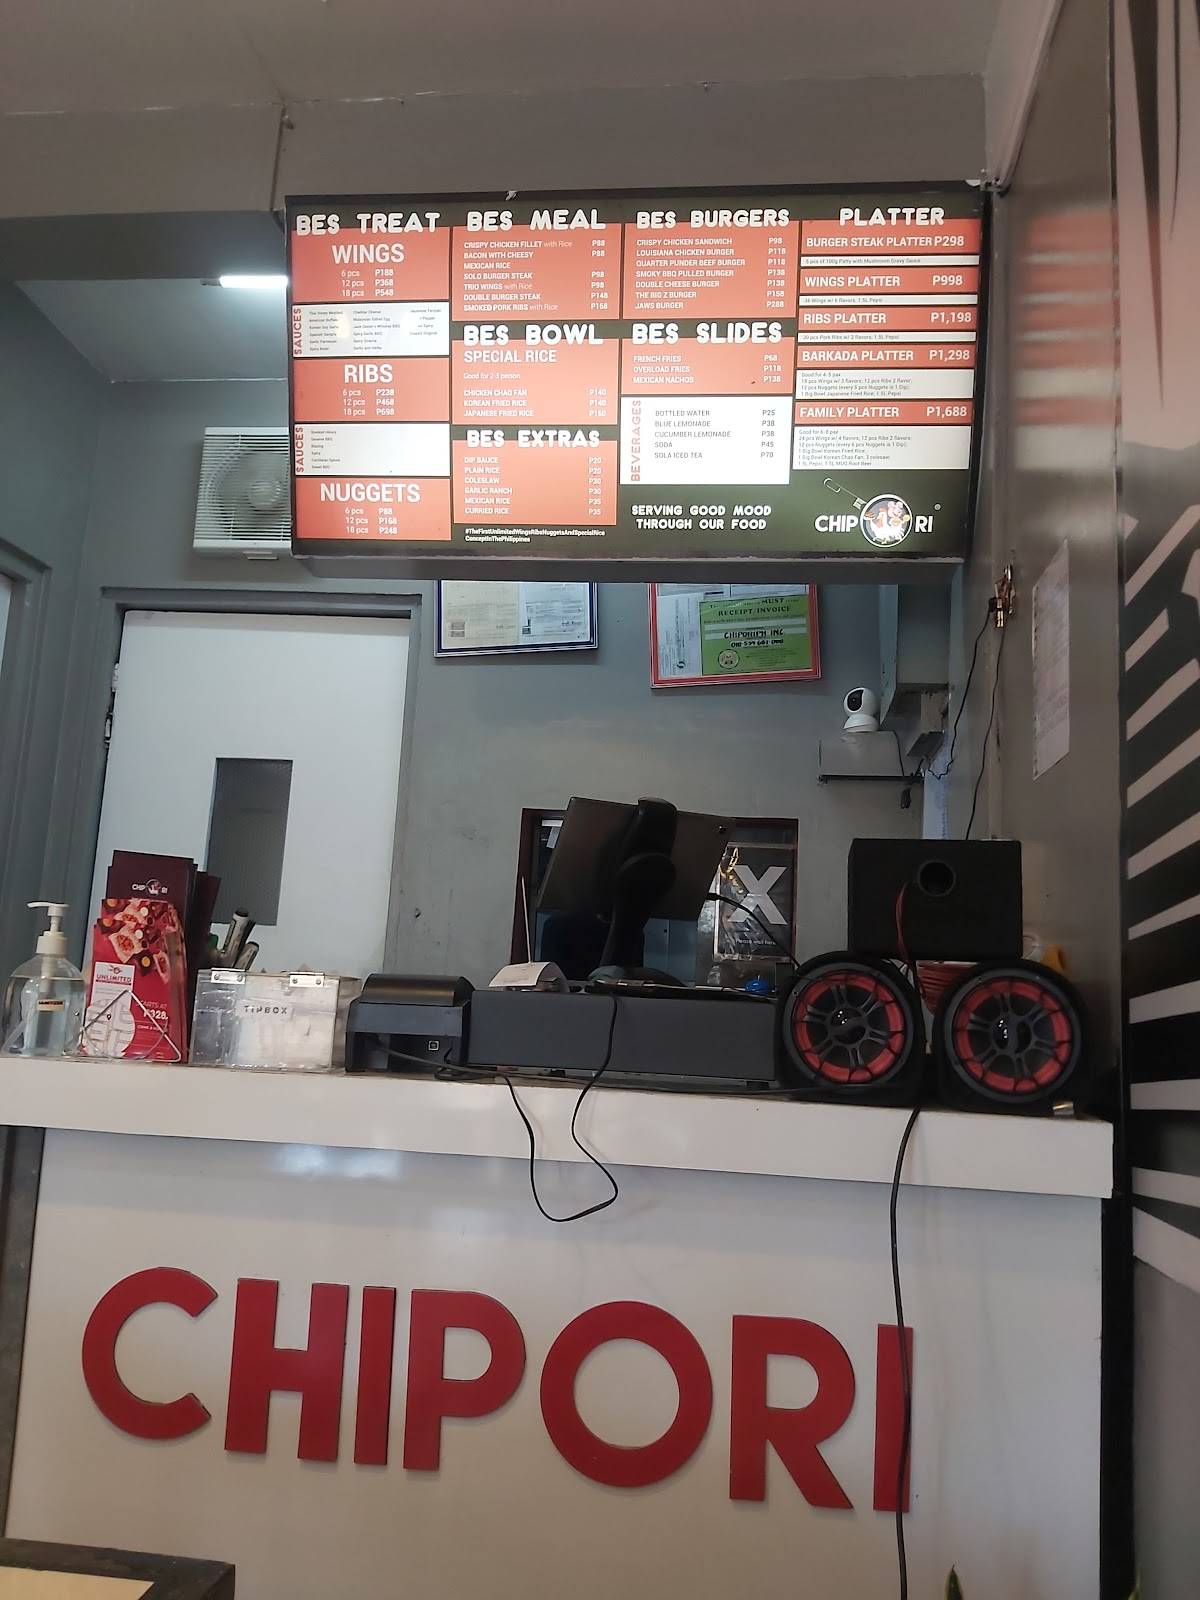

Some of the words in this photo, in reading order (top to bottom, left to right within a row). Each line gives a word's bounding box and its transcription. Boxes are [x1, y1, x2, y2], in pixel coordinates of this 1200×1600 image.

[297, 214, 339, 236] BES
[357, 213, 440, 234] TREAT
[467, 211, 512, 232] BES
[530, 209, 606, 230] MEAL
[637, 211, 676, 229] BES
[690, 209, 789, 228] BURGERS
[840, 208, 944, 226] PLATTER
[807, 238, 848, 246] BURGER
[851, 237, 883, 246] STEAK
[886, 237, 932, 246] PLATTER
[934, 236, 964, 246] P298
[332, 244, 404, 264] WINGS
[805, 277, 844, 286] WINGS
[848, 276, 900, 286] PLATTER
[933, 275, 962, 285] P998
[804, 314, 831, 323] RIBS
[834, 313, 886, 323] PLATTER
[931, 312, 971, 324] P1,198
[464, 324, 508, 346] BES
[526, 324, 603, 345] BOWL
[633, 323, 678, 344] BES
[697, 322, 781, 344] SLIDES
[464, 350, 521, 363] SPECIAL
[526, 350, 557, 362] RICE
[803, 351, 858, 360] BARKADA
[862, 351, 914, 360] PLATTER
[930, 350, 970, 362] P1,298
[344, 364, 392, 383] RIBS
[800, 408, 844, 417] FAMILY
[847, 407, 899, 417] PLATTER
[927, 407, 967, 418] P1,688
[467, 430, 504, 448] BES
[518, 429, 600, 448] EXTRAS
[631, 400, 641, 481] BEVERAGES
[296, 427, 304, 472] SAUCES
[320, 483, 420, 502] NUGGETS
[631, 505, 682, 516] SERVING
[690, 505, 725, 516] GOOD
[733, 505, 771, 516] MOOD
[636, 519, 692, 530] THROUGH
[699, 519, 724, 530] OUR
[732, 519, 766, 530] FOOD
[719, 606, 789, 616] RECEIPT/INVOICE
[728, 865, 788, 925] X
[82, 1266, 914, 1512] CHIPORI
